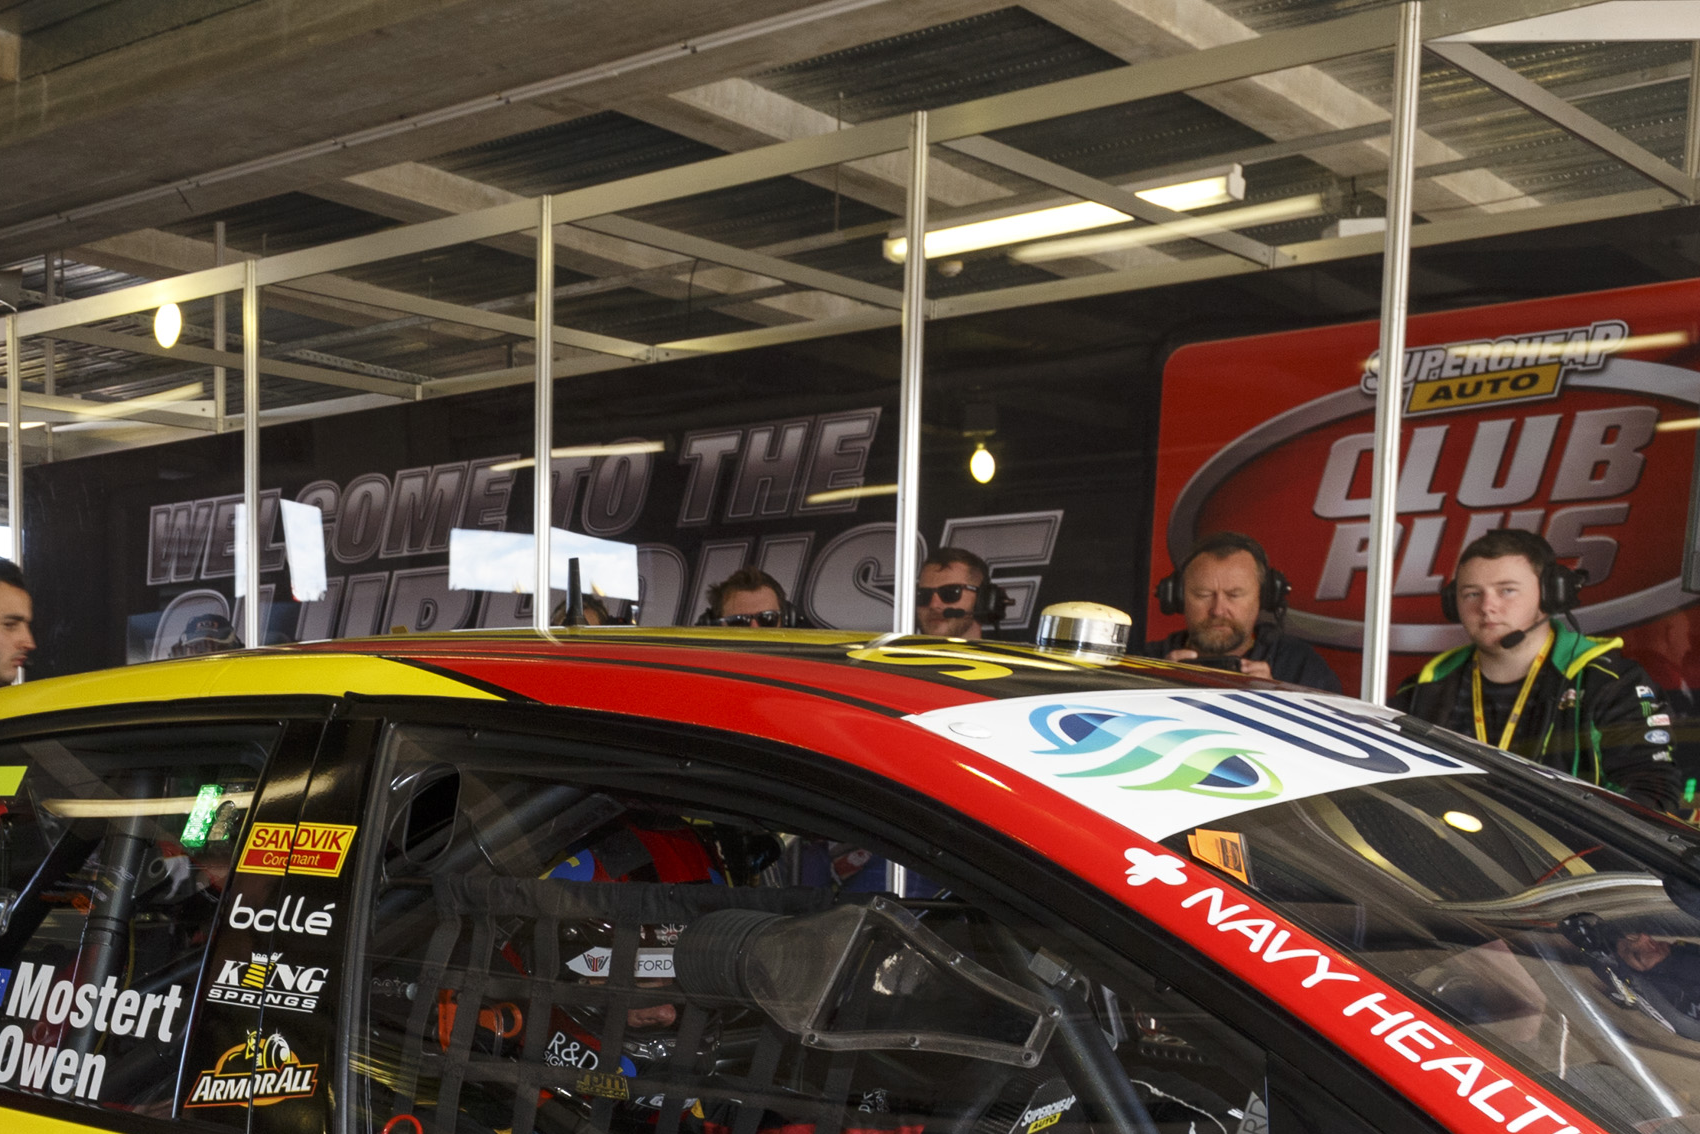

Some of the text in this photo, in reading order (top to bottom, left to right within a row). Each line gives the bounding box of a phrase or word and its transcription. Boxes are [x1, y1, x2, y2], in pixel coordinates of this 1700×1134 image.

[1361, 320, 1629, 393] SUPERCHEAP
[1427, 372, 1540, 401] AUTO
[1313, 405, 1660, 520] CLUB
[147, 407, 882, 586] WELCOME TO THE
[251, 828, 348, 851] SANDVIK
[1181, 886, 1360, 989] NAVY
[5, 961, 182, 1042] Mostert
[208, 987, 318, 1010] SPRINGS
[547, 1031, 599, 1071] R&D
[1028, 1112, 1061, 1133] AUTO
